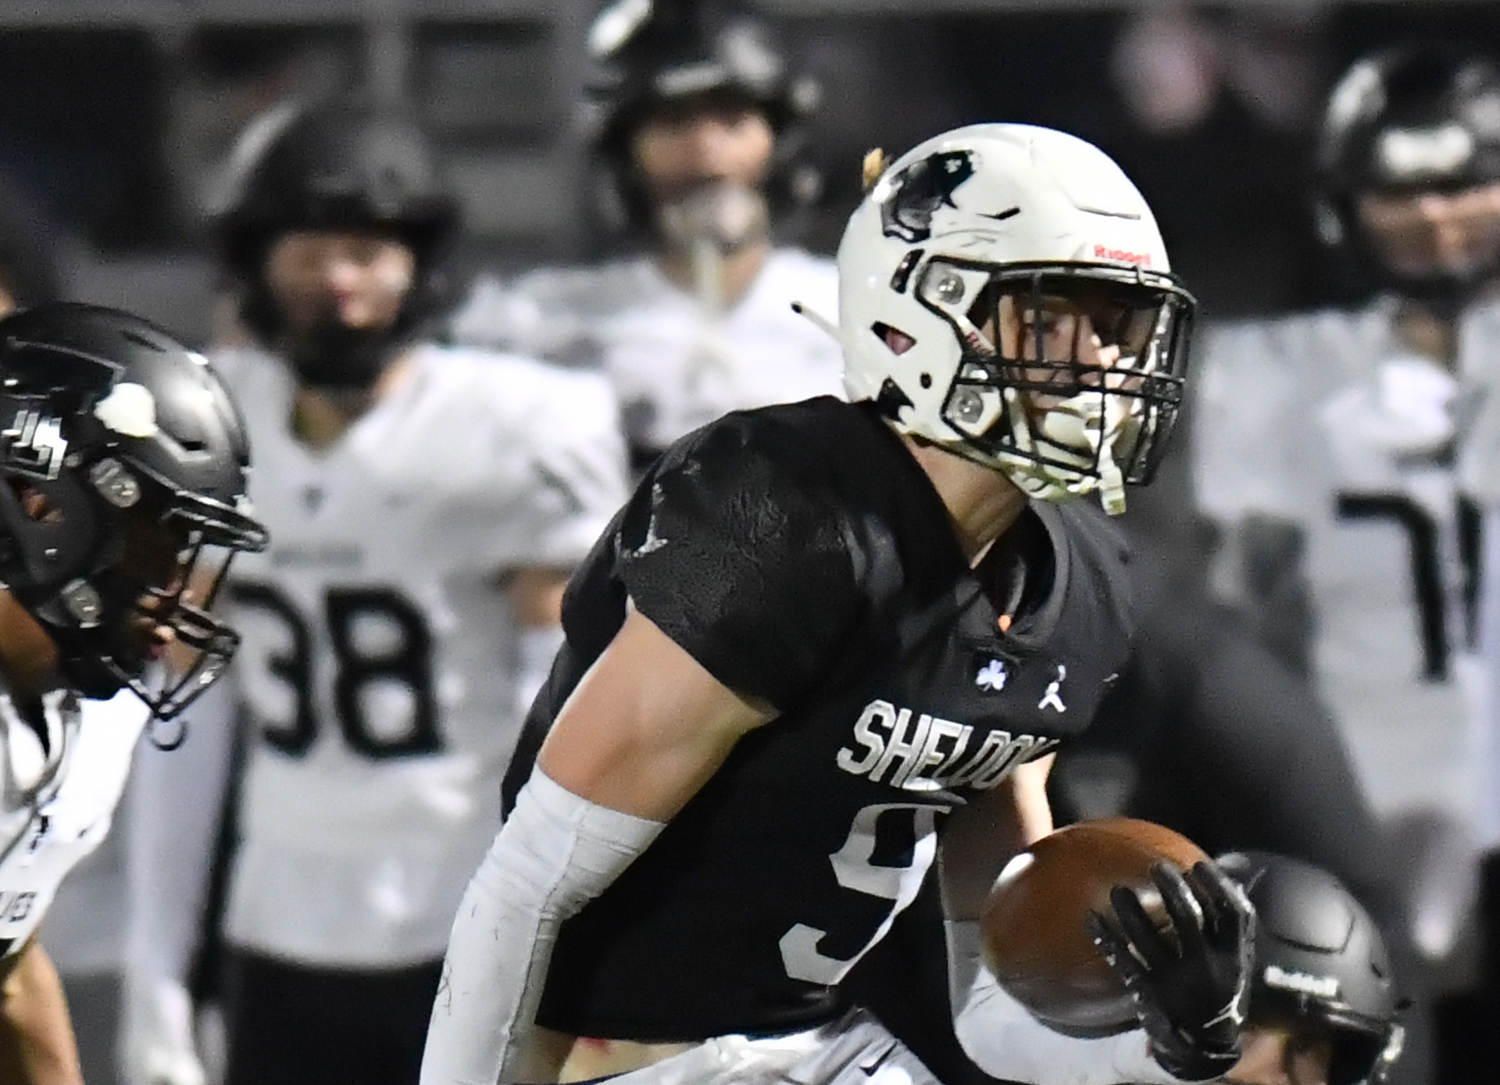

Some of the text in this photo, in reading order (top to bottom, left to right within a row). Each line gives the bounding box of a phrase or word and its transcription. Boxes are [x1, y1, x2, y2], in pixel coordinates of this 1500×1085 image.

[224, 577, 448, 762] 38
[1335, 490, 1482, 684] 7
[778, 802, 953, 987] 9
